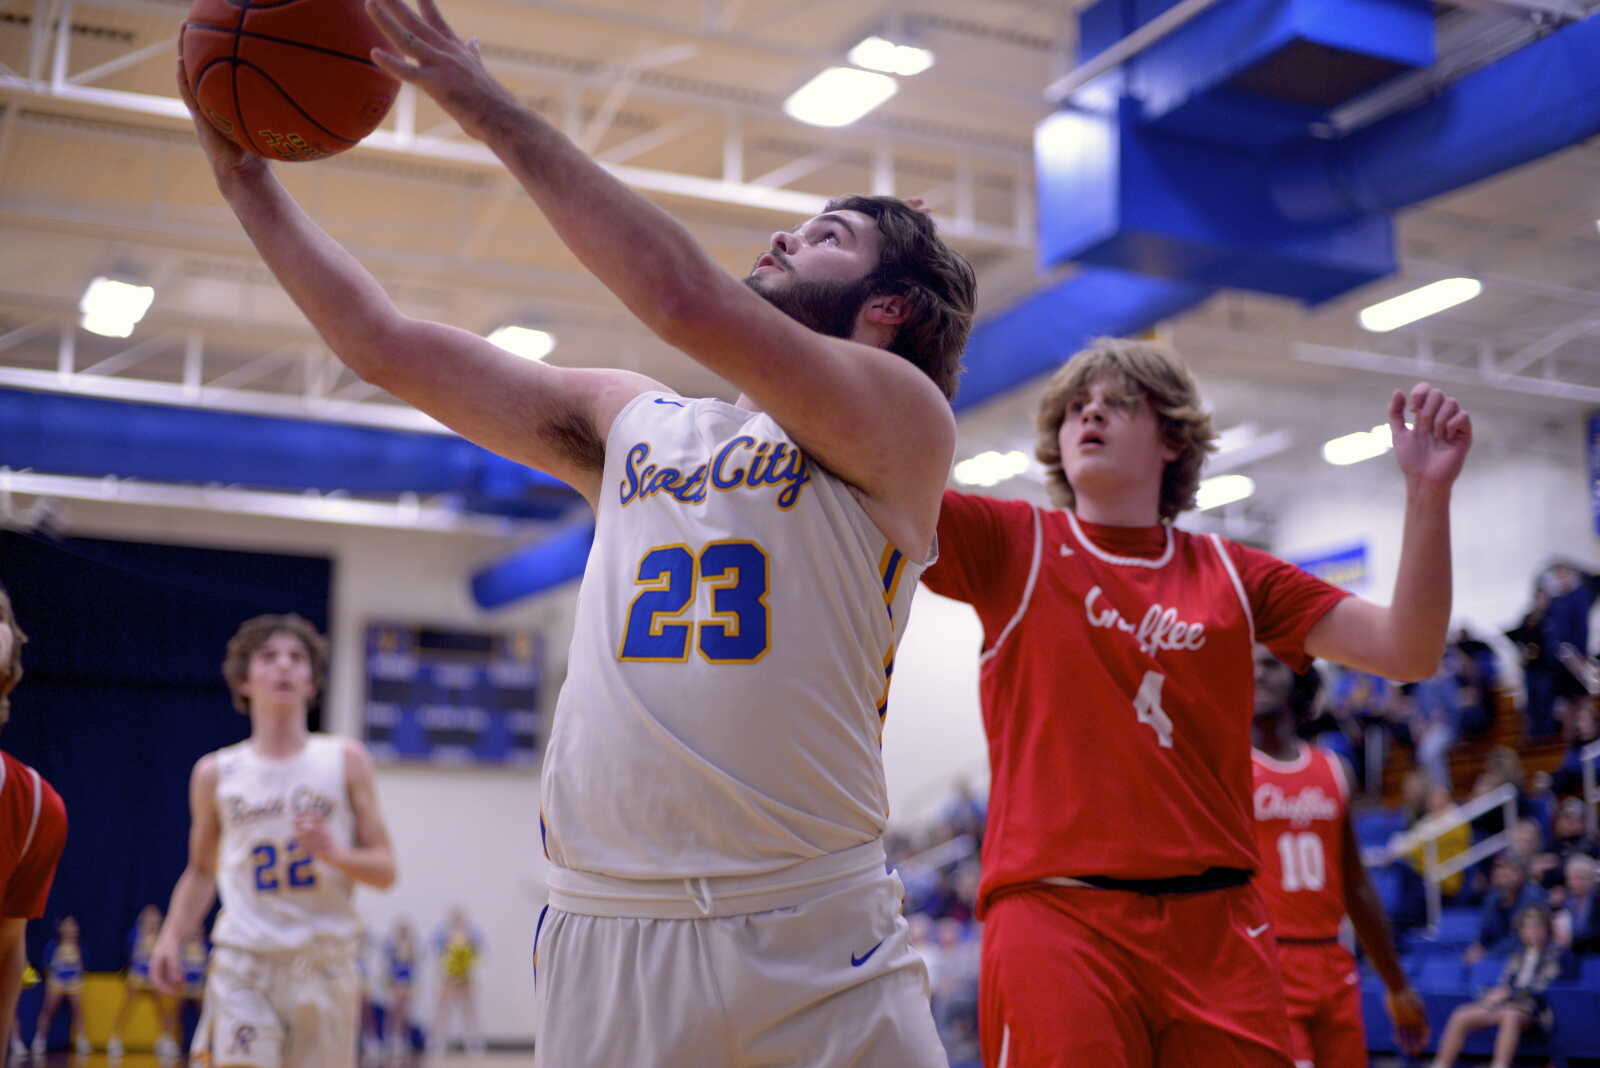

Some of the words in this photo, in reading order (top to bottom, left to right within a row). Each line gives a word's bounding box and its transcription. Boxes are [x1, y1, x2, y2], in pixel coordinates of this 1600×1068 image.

[711, 435, 811, 511] City
[618, 539, 773, 664] 23
[1084, 585, 1206, 659] Cffee
[1132, 670, 1174, 748] 4
[250, 839, 320, 892] 22
[1277, 831, 1326, 892] 10
